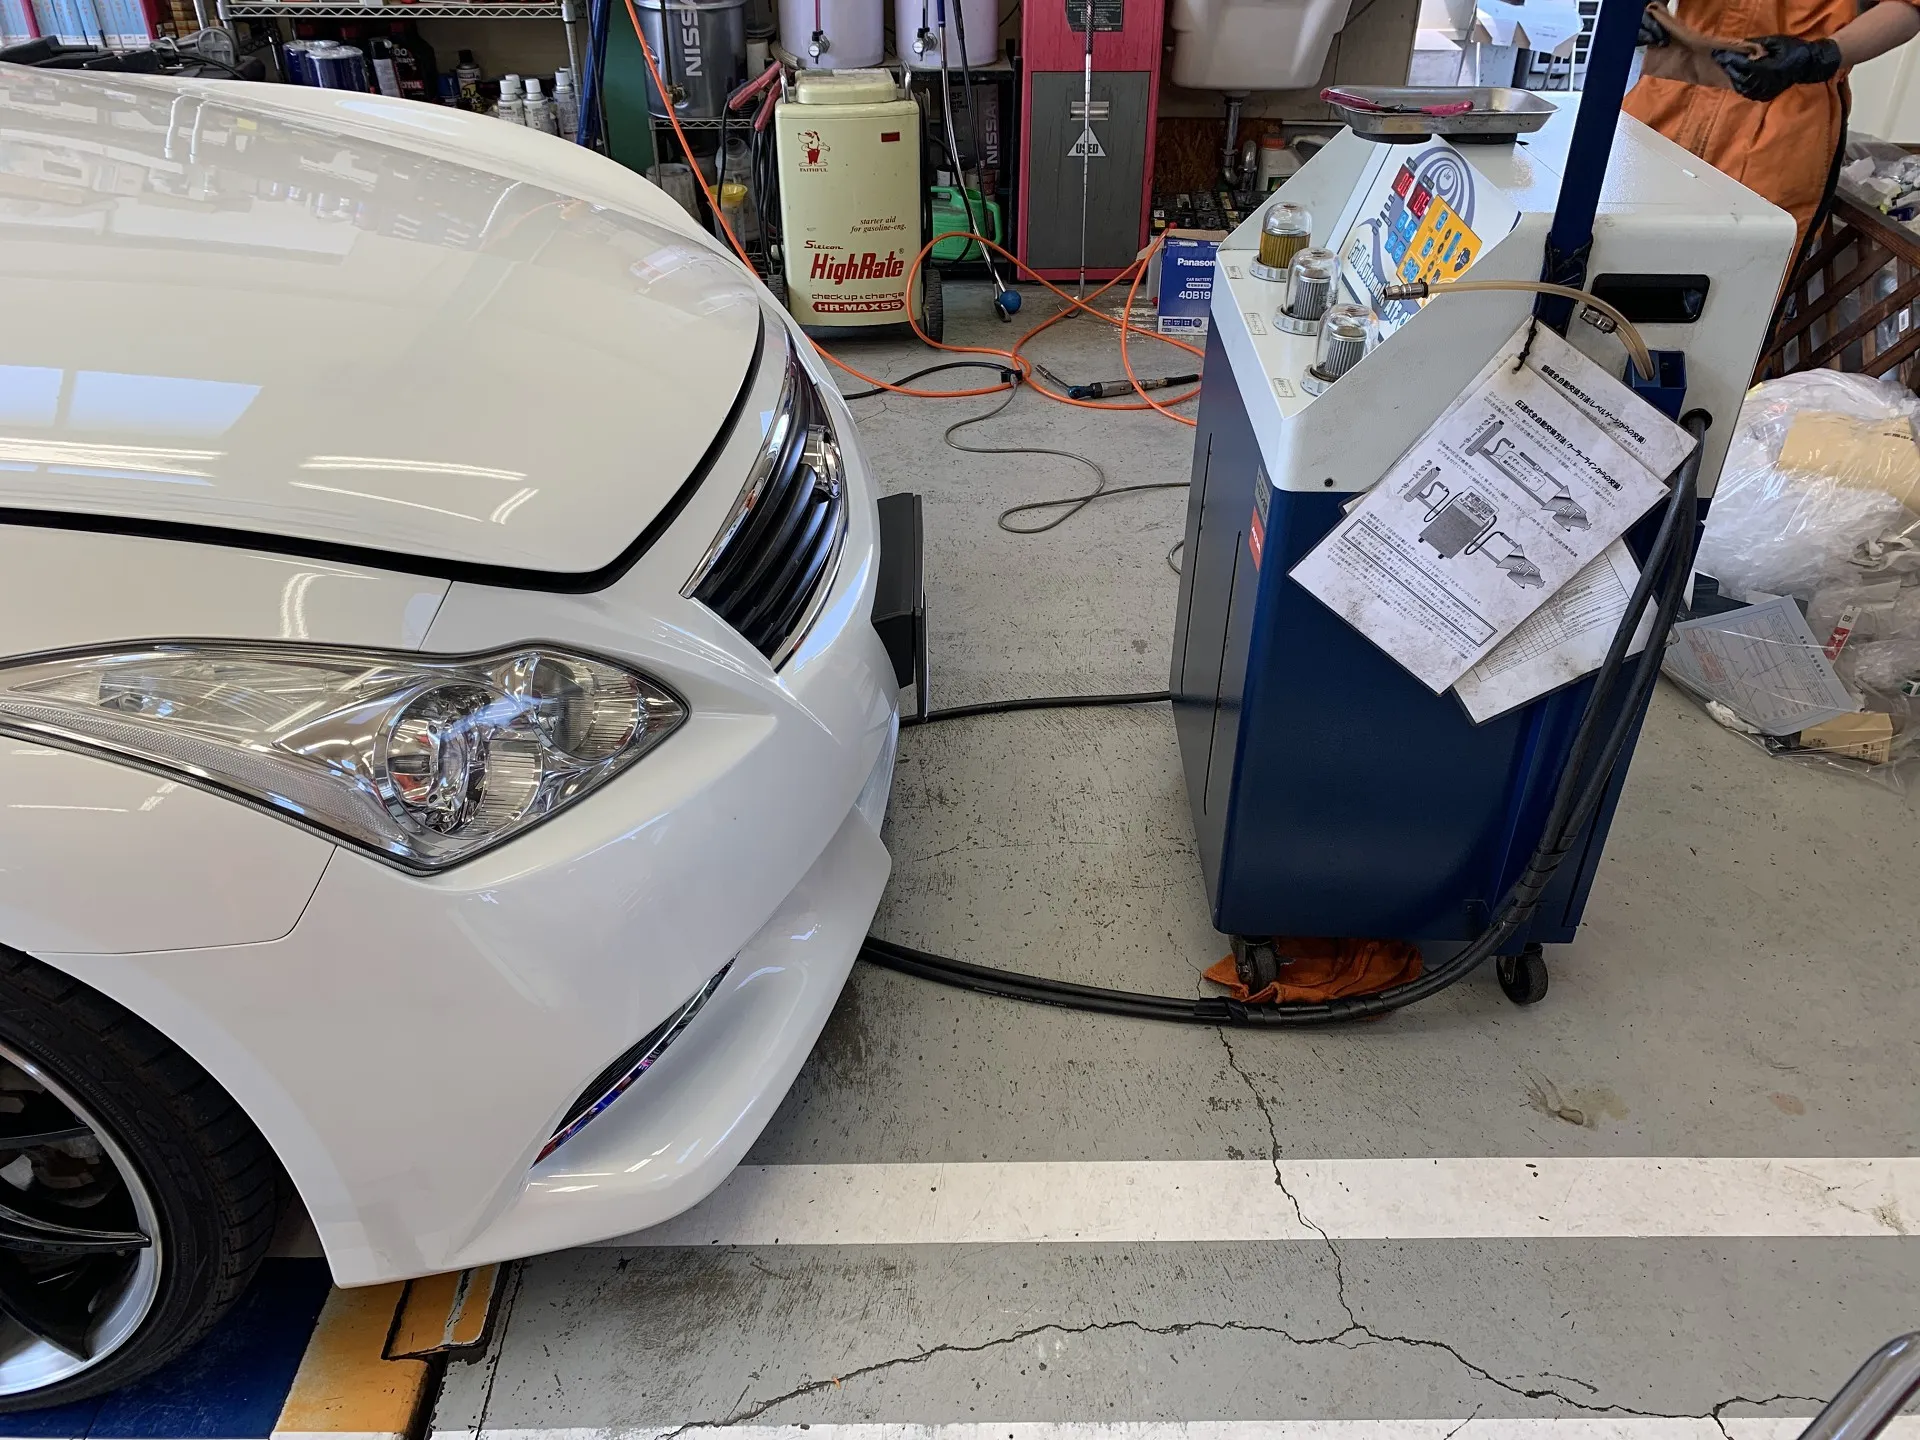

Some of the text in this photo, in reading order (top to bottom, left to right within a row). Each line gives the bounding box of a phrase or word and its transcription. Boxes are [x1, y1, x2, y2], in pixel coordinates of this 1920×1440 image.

[860, 215, 897, 226] starter aid
[849, 226, 862, 234] for
[810, 250, 905, 286] HighRate
[865, 291, 905, 300] charge
[1178, 290, 1211, 300] 40B19
[817, 302, 901, 312] HR-MAX55
[1559, 502, 1583, 520] AT
[1512, 561, 1535, 577] AT
